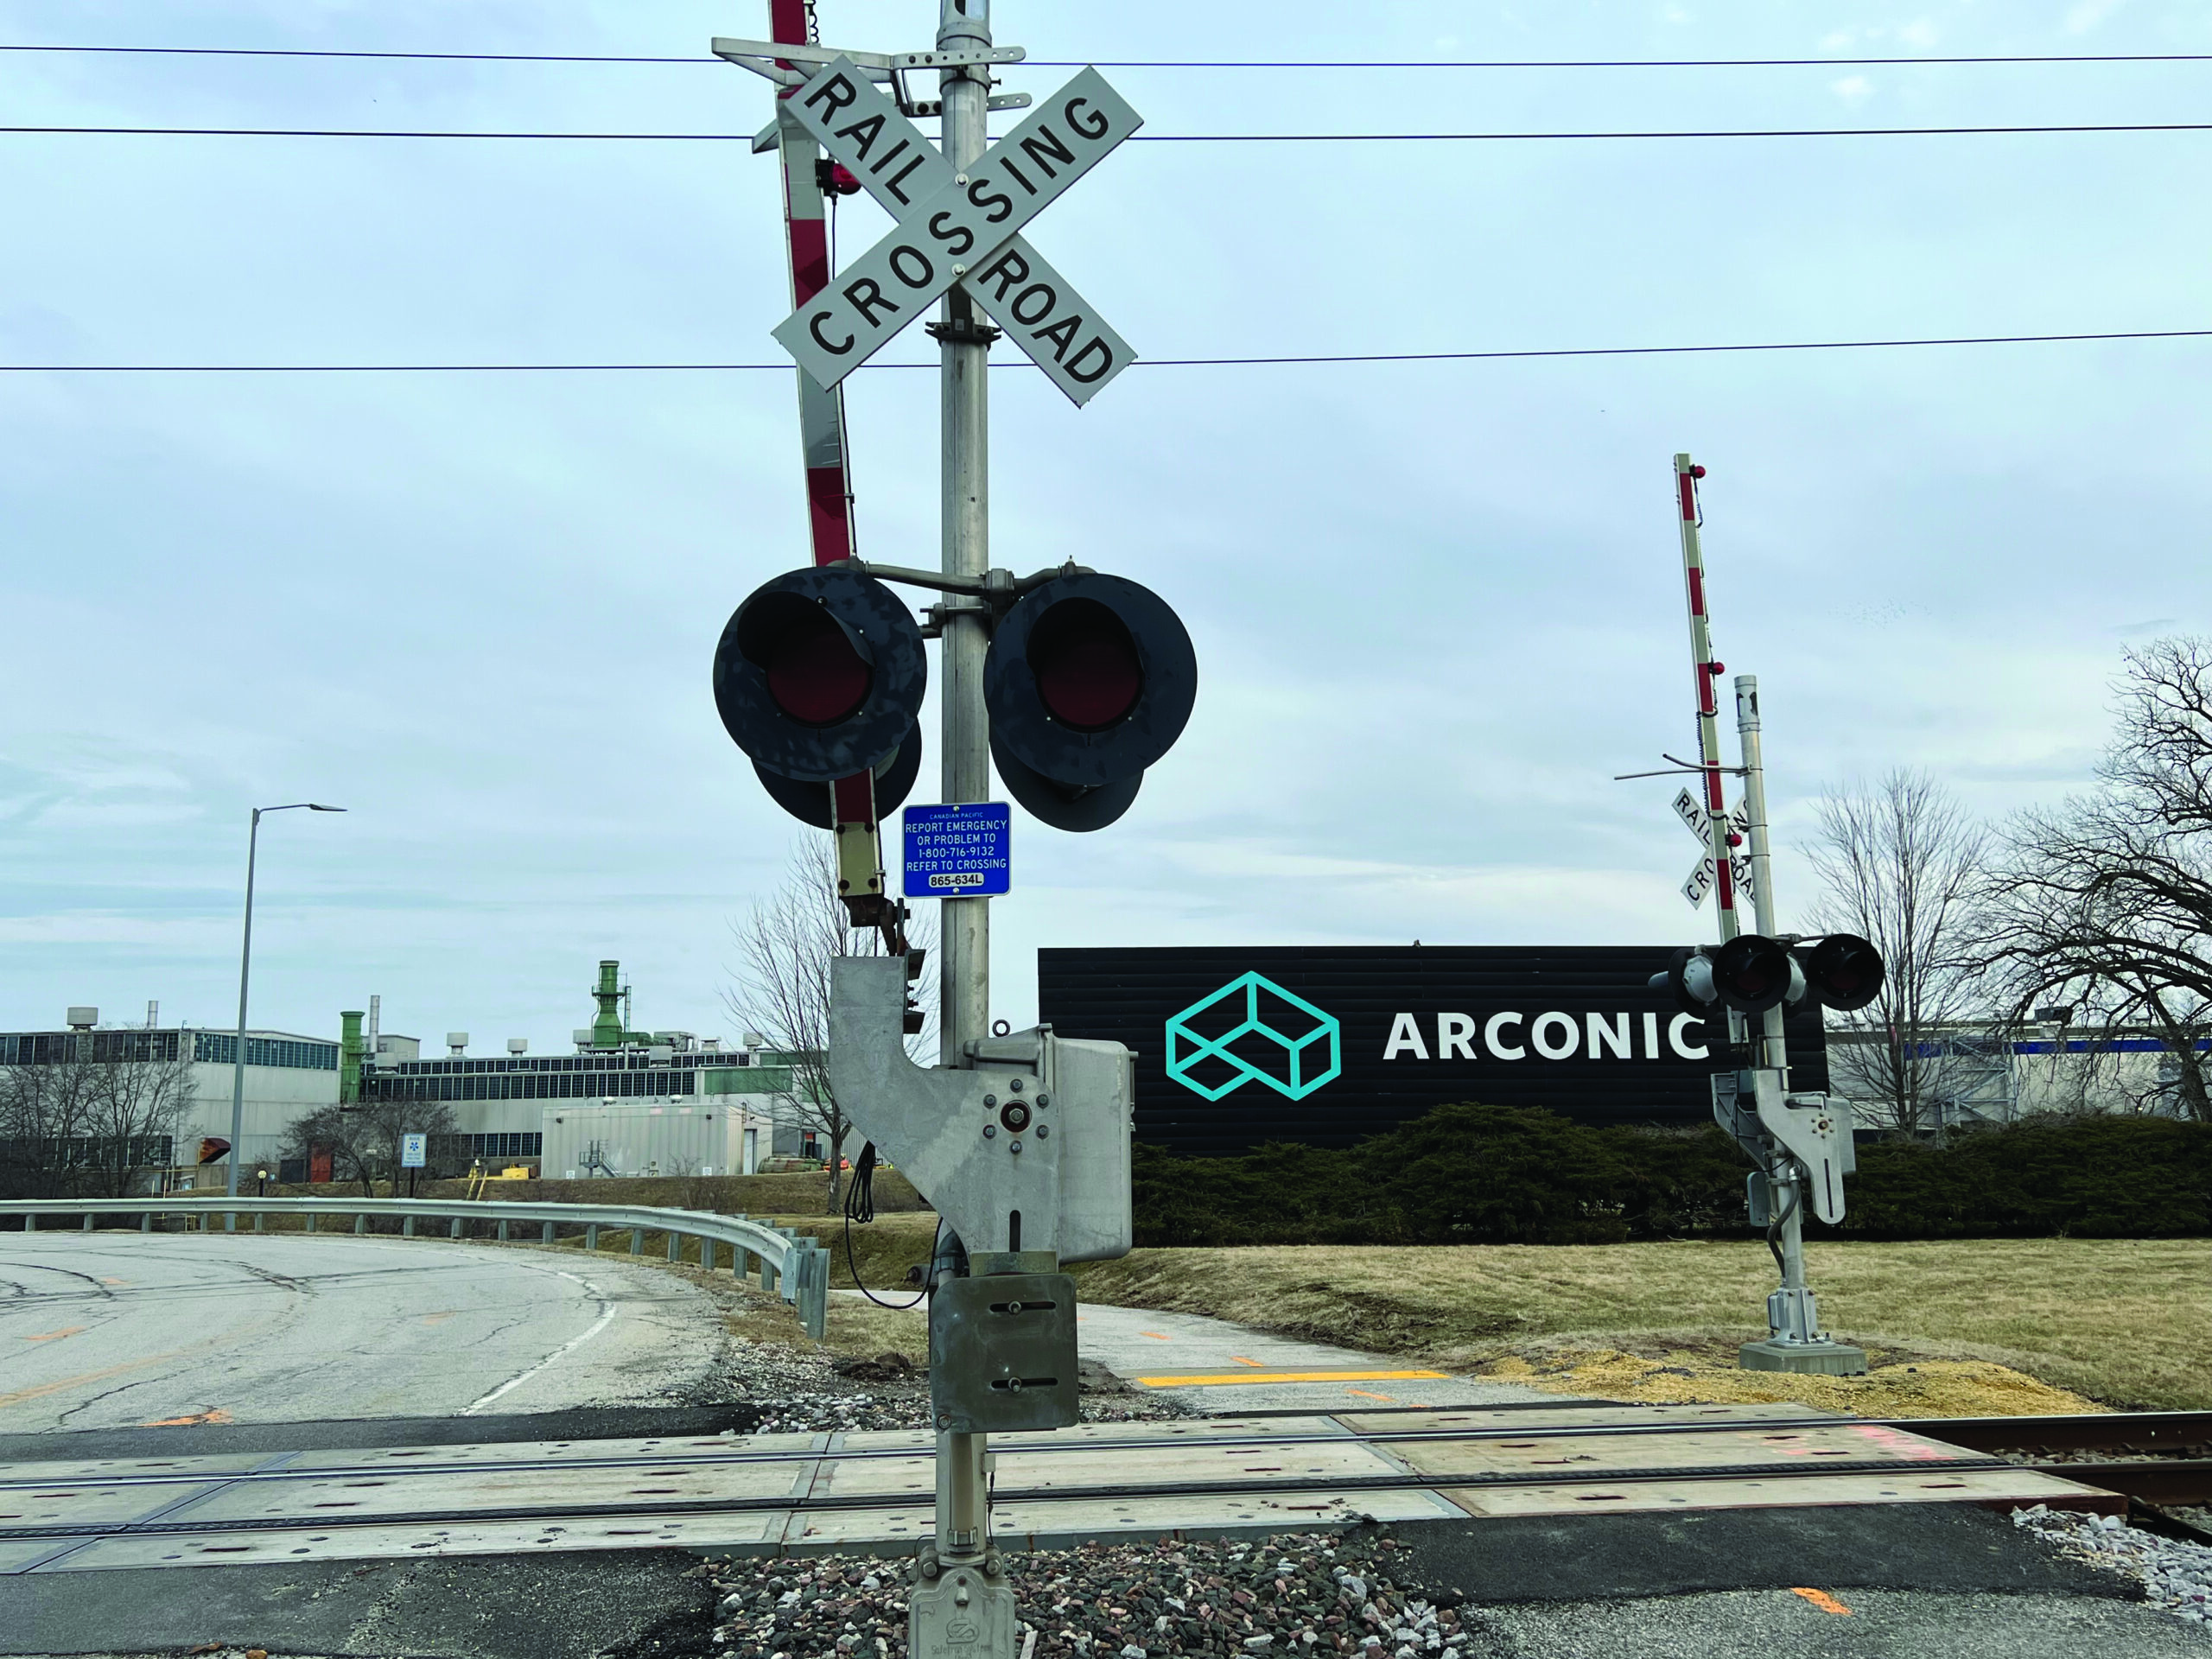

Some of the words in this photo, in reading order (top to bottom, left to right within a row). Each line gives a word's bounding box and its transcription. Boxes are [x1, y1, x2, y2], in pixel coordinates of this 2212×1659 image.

[804, 72, 925, 206] RAIL
[977, 248, 1113, 384] ROAD
[810, 97, 1109, 356] CROSSING
[1677, 793, 1710, 845] RAIL
[906, 823, 943, 833] REPORT
[947, 820, 1007, 831] EMERGENCY
[917, 836, 931, 845] OR
[934, 834, 981, 844] PROBLEM
[984, 833, 995, 842] TO
[919, 846, 995, 858] 1-800-716-9132
[906, 861, 938, 871] REFER
[941, 861, 953, 870] TO
[957, 858, 1007, 870] CROSSING
[931, 874, 982, 886] 865-634L
[1382, 1011, 1710, 1060] ARCONIC
